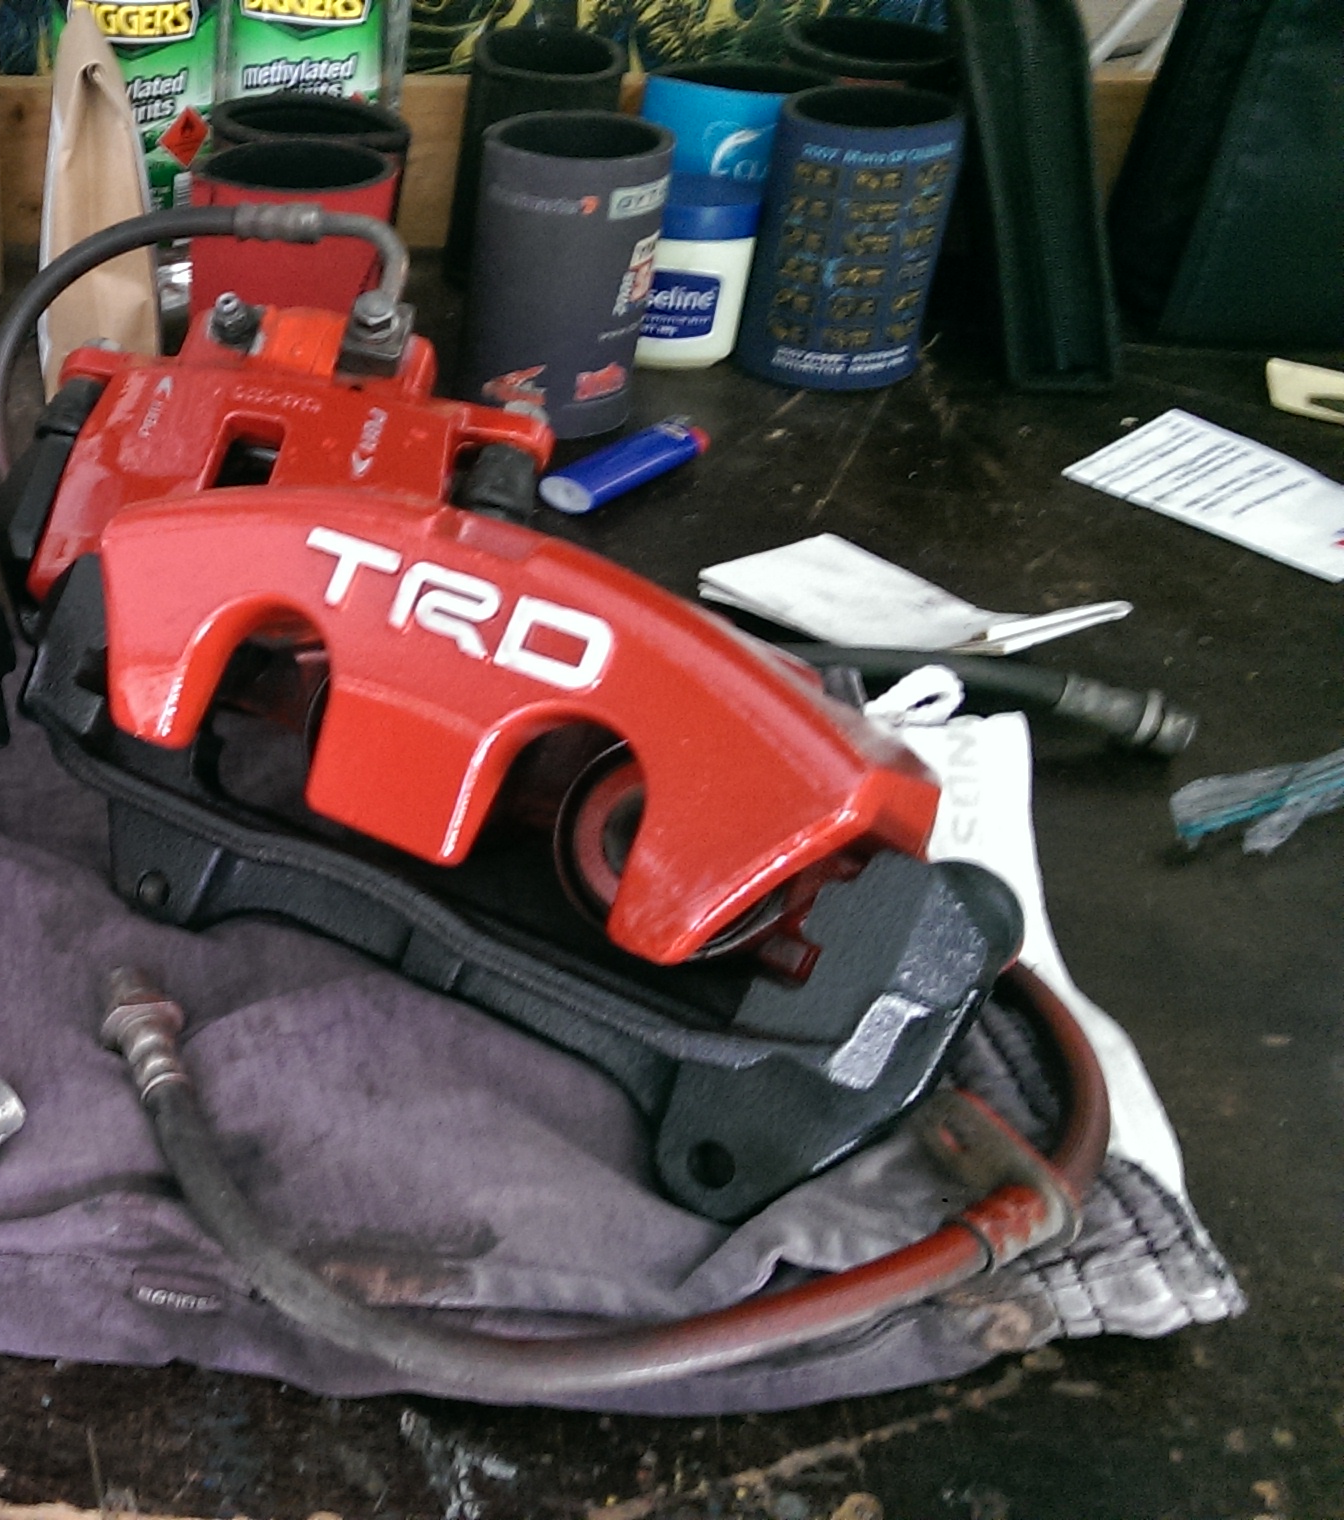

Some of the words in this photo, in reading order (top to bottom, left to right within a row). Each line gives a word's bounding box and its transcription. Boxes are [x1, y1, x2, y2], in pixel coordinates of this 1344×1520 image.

[73, 0, 190, 36] GGERS
[126, 67, 188, 99] lated
[243, 53, 358, 89] methylated
[648, 285, 718, 311] seline
[305, 526, 614, 690] TRD
